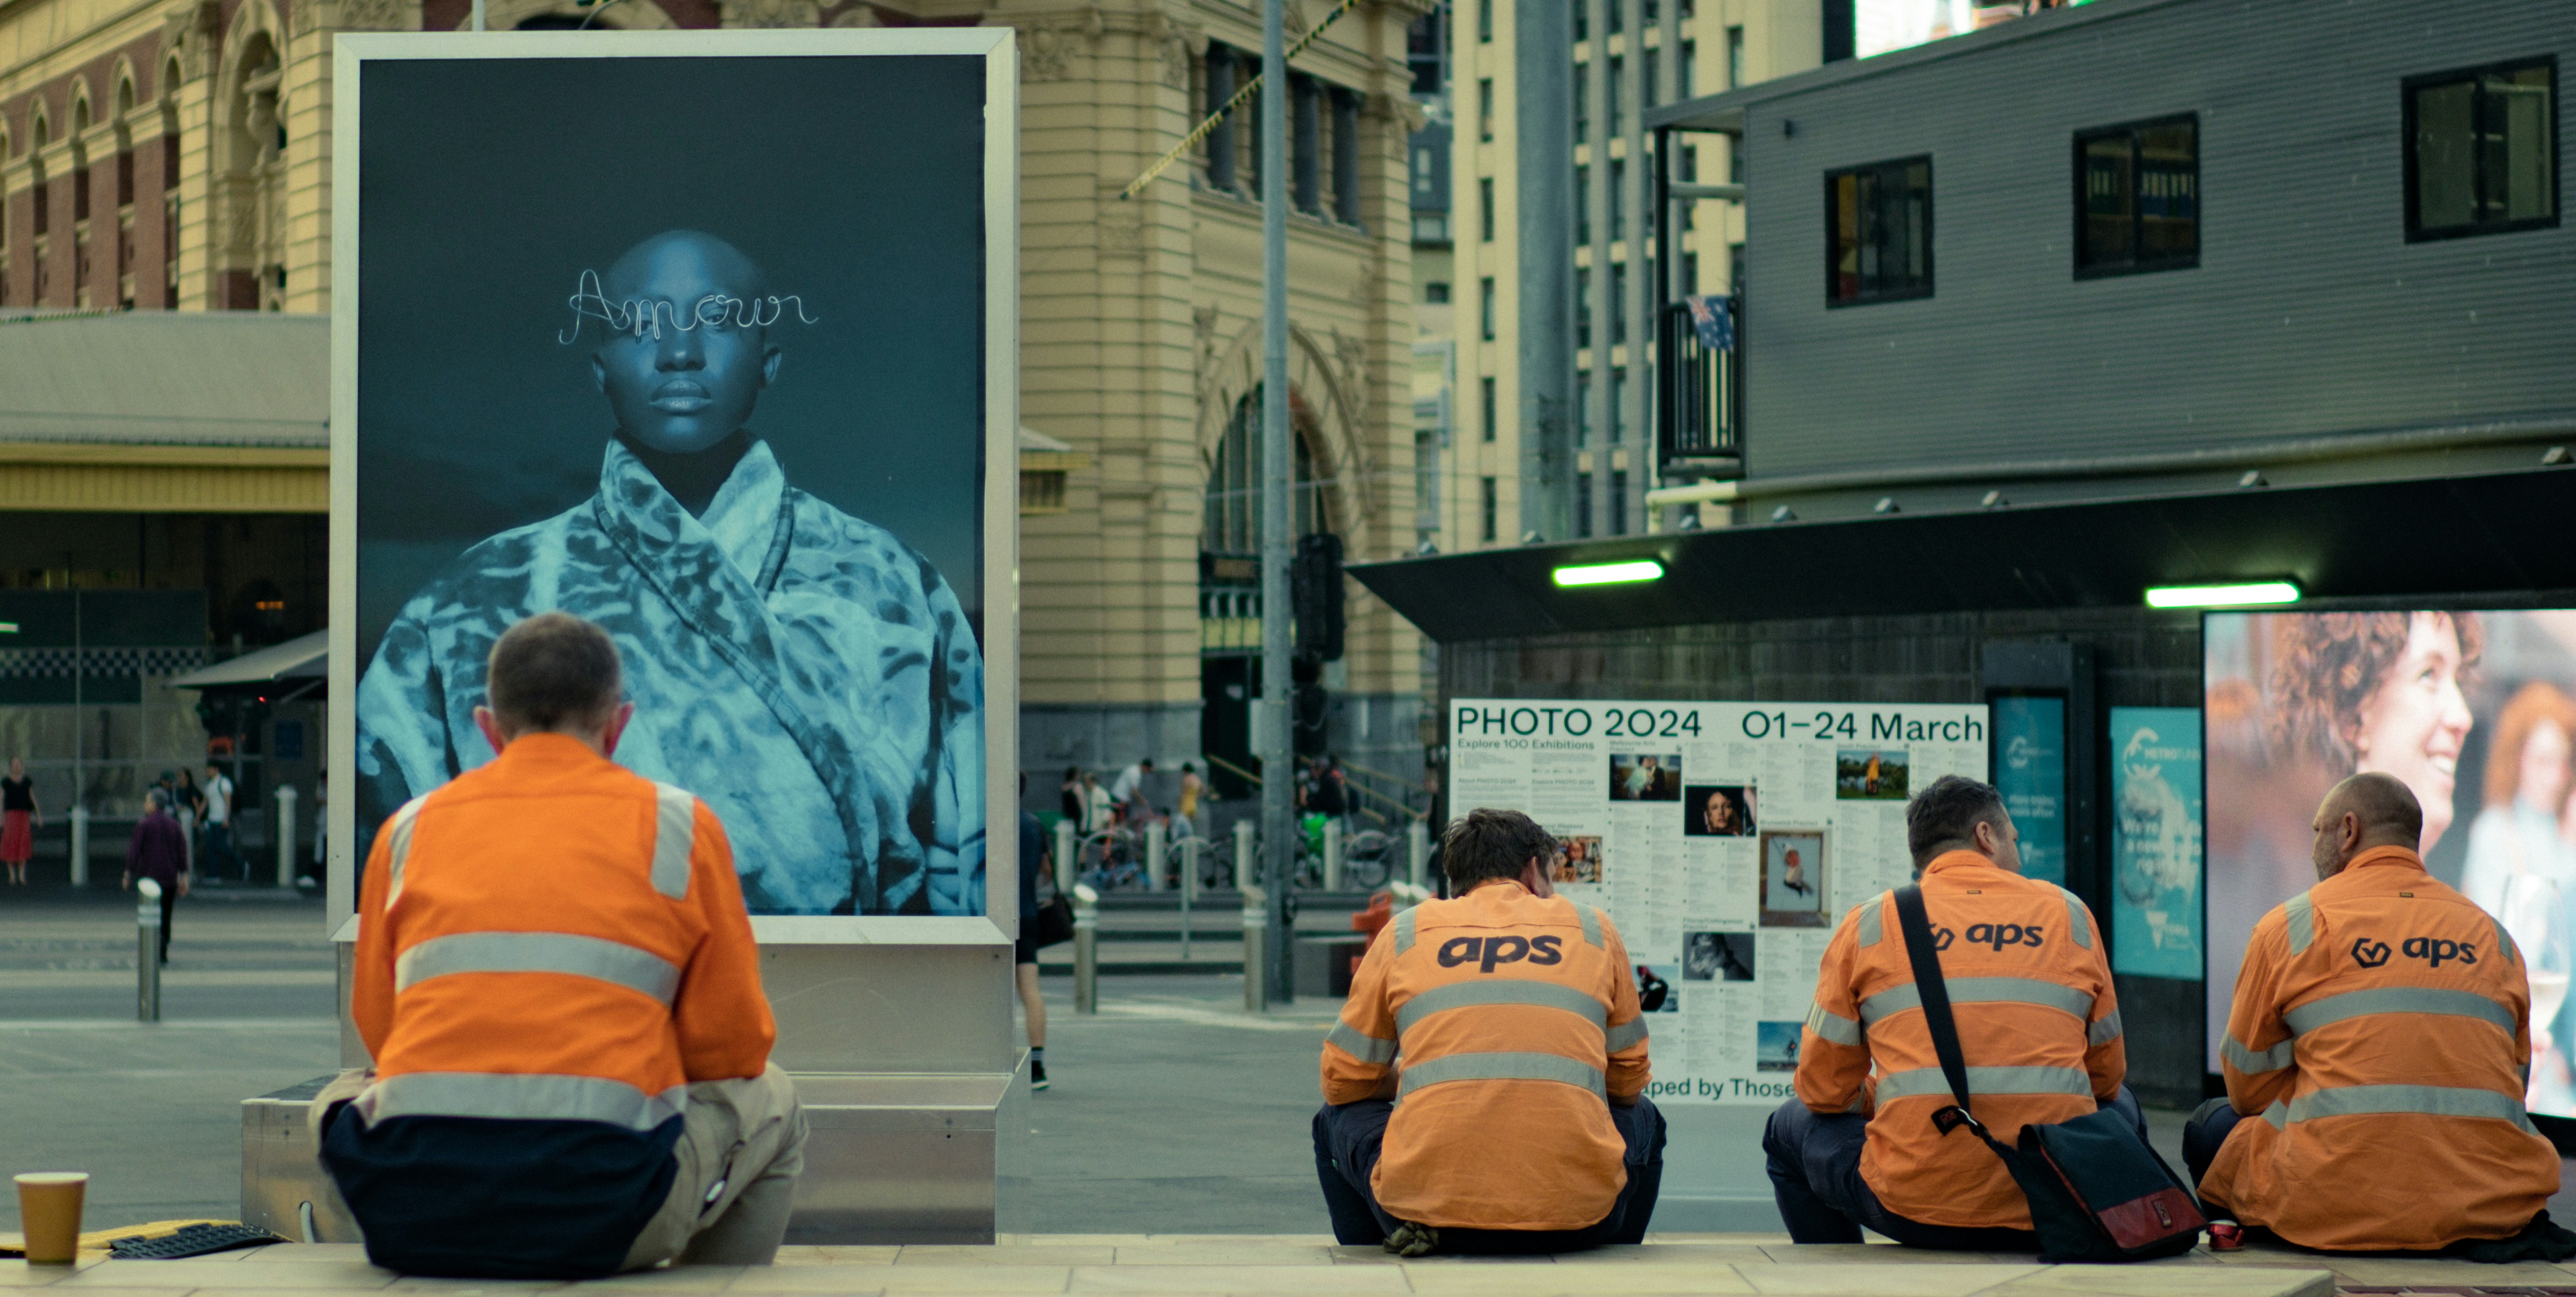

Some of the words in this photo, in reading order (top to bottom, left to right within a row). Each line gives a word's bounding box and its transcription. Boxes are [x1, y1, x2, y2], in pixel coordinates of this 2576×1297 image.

[559, 268, 819, 345] Amour
[1457, 707, 1592, 736] PHOTO
[1604, 708, 1702, 737] 2024
[1871, 712, 1982, 741] March
[1458, 738, 1500, 749] Explore
[1504, 739, 1528, 748] 100
[1532, 740, 1595, 750] Exhibitions
[1965, 923, 2043, 952] aps
[2402, 937, 2478, 968] aps
[1437, 934, 1562, 974] aps
[1698, 1078, 1724, 1100] by
[1729, 1078, 1796, 1097] Those
